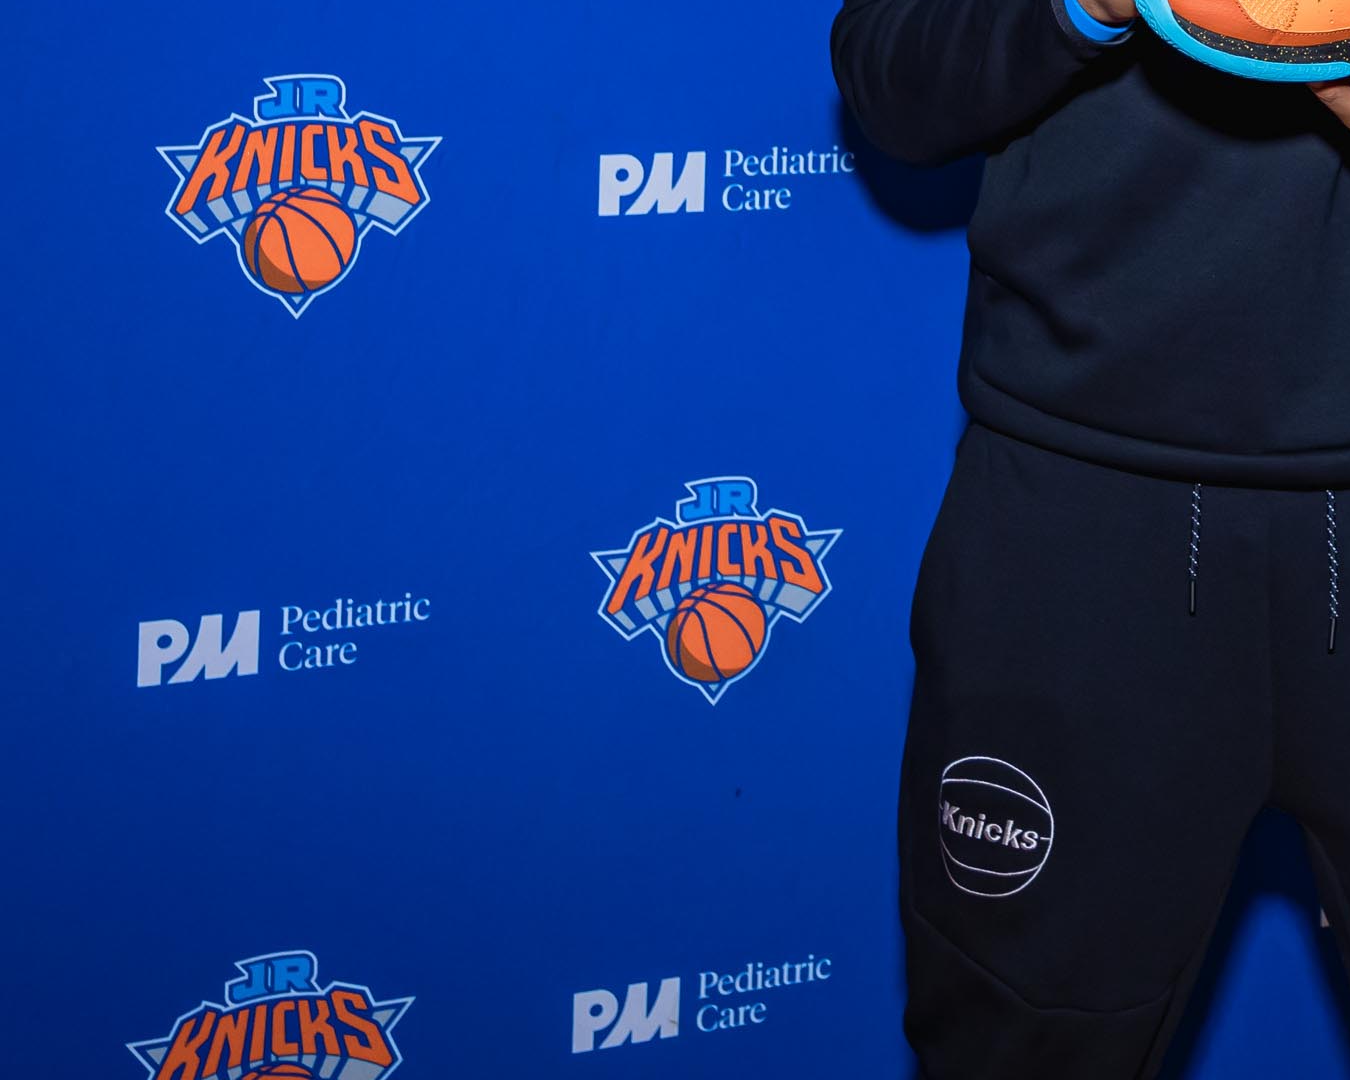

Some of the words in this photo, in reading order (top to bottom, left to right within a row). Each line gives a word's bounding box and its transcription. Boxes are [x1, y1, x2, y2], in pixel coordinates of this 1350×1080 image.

[261, 80, 339, 119] JR
[176, 120, 420, 214] KNICKS
[598, 151, 706, 217] PM
[723, 145, 855, 178] Pediatric
[721, 183, 792, 212] Care
[682, 483, 751, 520] JR
[608, 517, 823, 614] KNICKS
[280, 591, 431, 637] Pediatric
[137, 610, 261, 688] PM
[278, 640, 358, 672] Care
[942, 800, 1039, 851] Knicks
[231, 957, 313, 1001] JR
[698, 954, 832, 1000] Pediatric
[155, 990, 393, 1080] KNICKS
[572, 977, 681, 1053] PM
[696, 1001, 767, 1033] Care
